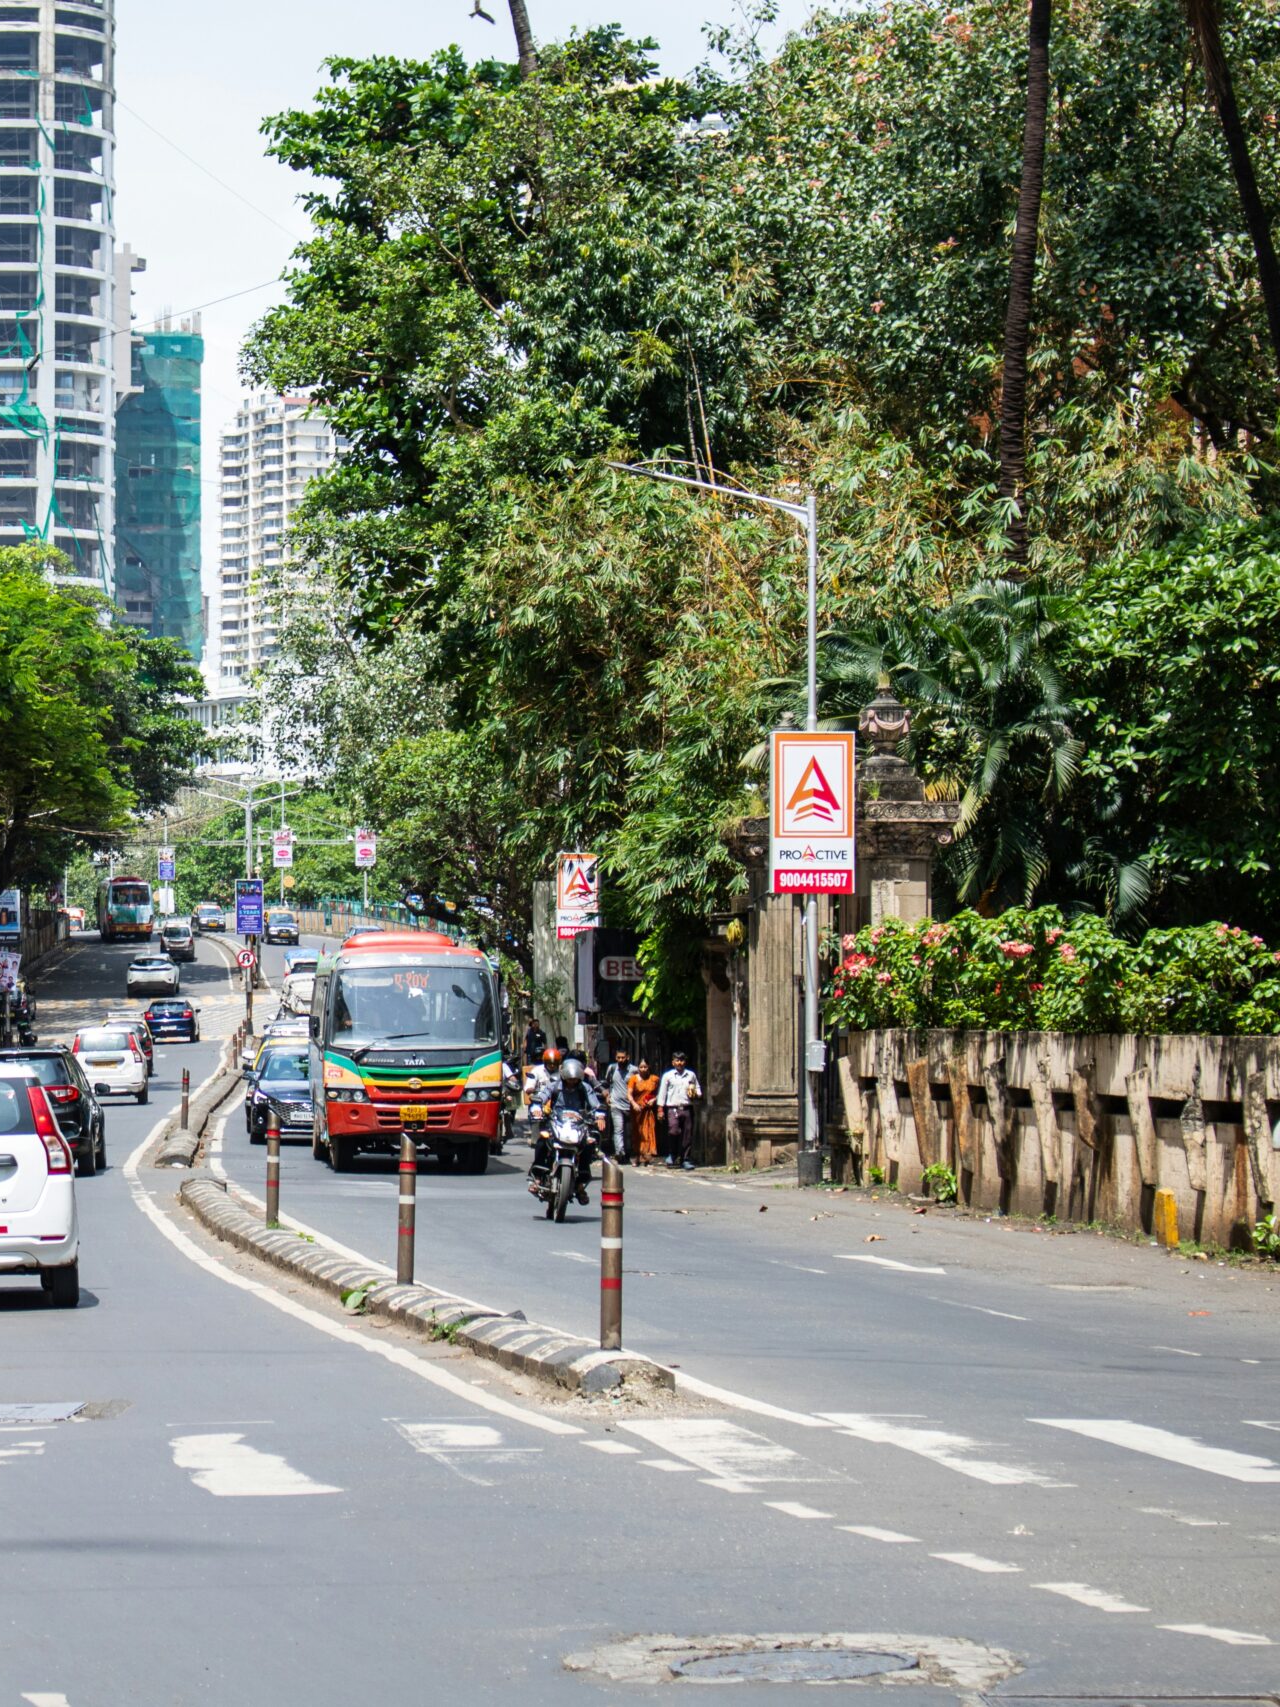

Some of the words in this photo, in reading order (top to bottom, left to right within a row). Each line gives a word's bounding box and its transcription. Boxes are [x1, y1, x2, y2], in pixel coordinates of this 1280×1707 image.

[779, 845, 848, 862] PROACTIVE
[779, 873, 848, 887] 9004415507
[606, 960, 644, 977] BES
